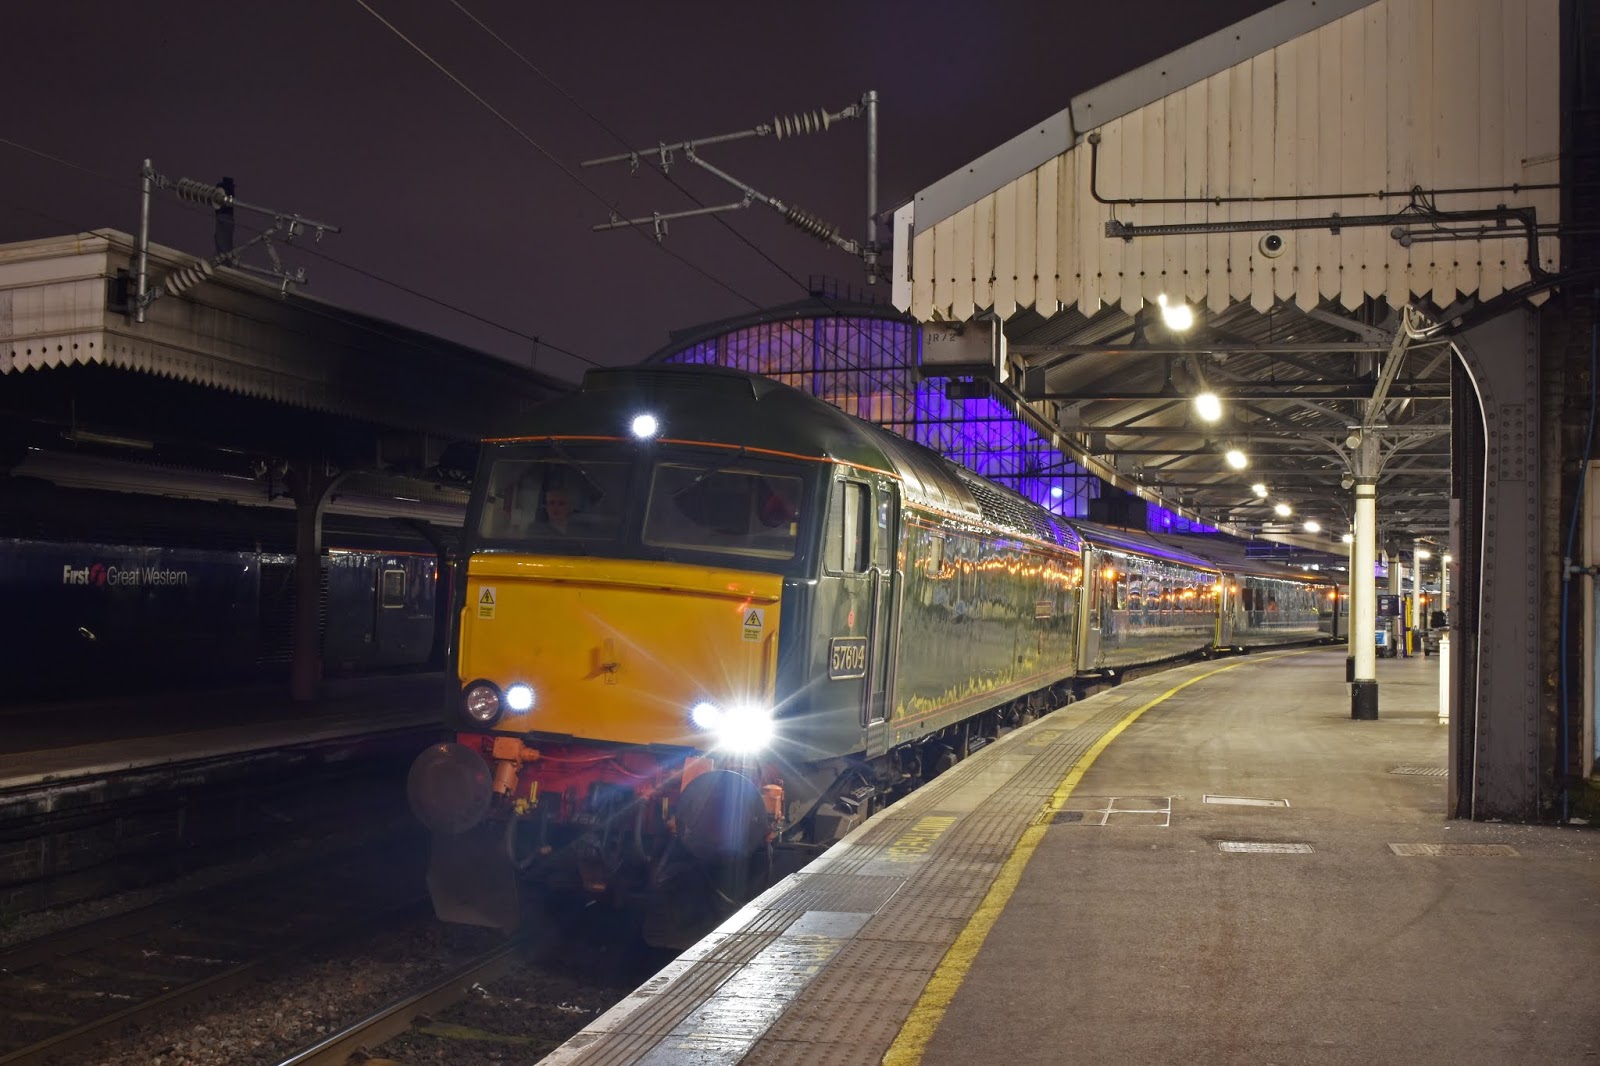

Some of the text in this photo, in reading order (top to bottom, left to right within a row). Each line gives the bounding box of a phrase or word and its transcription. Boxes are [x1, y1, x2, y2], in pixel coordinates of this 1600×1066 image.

[63, 565, 187, 585] First Great Western
[832, 646, 865, 670] 57604
